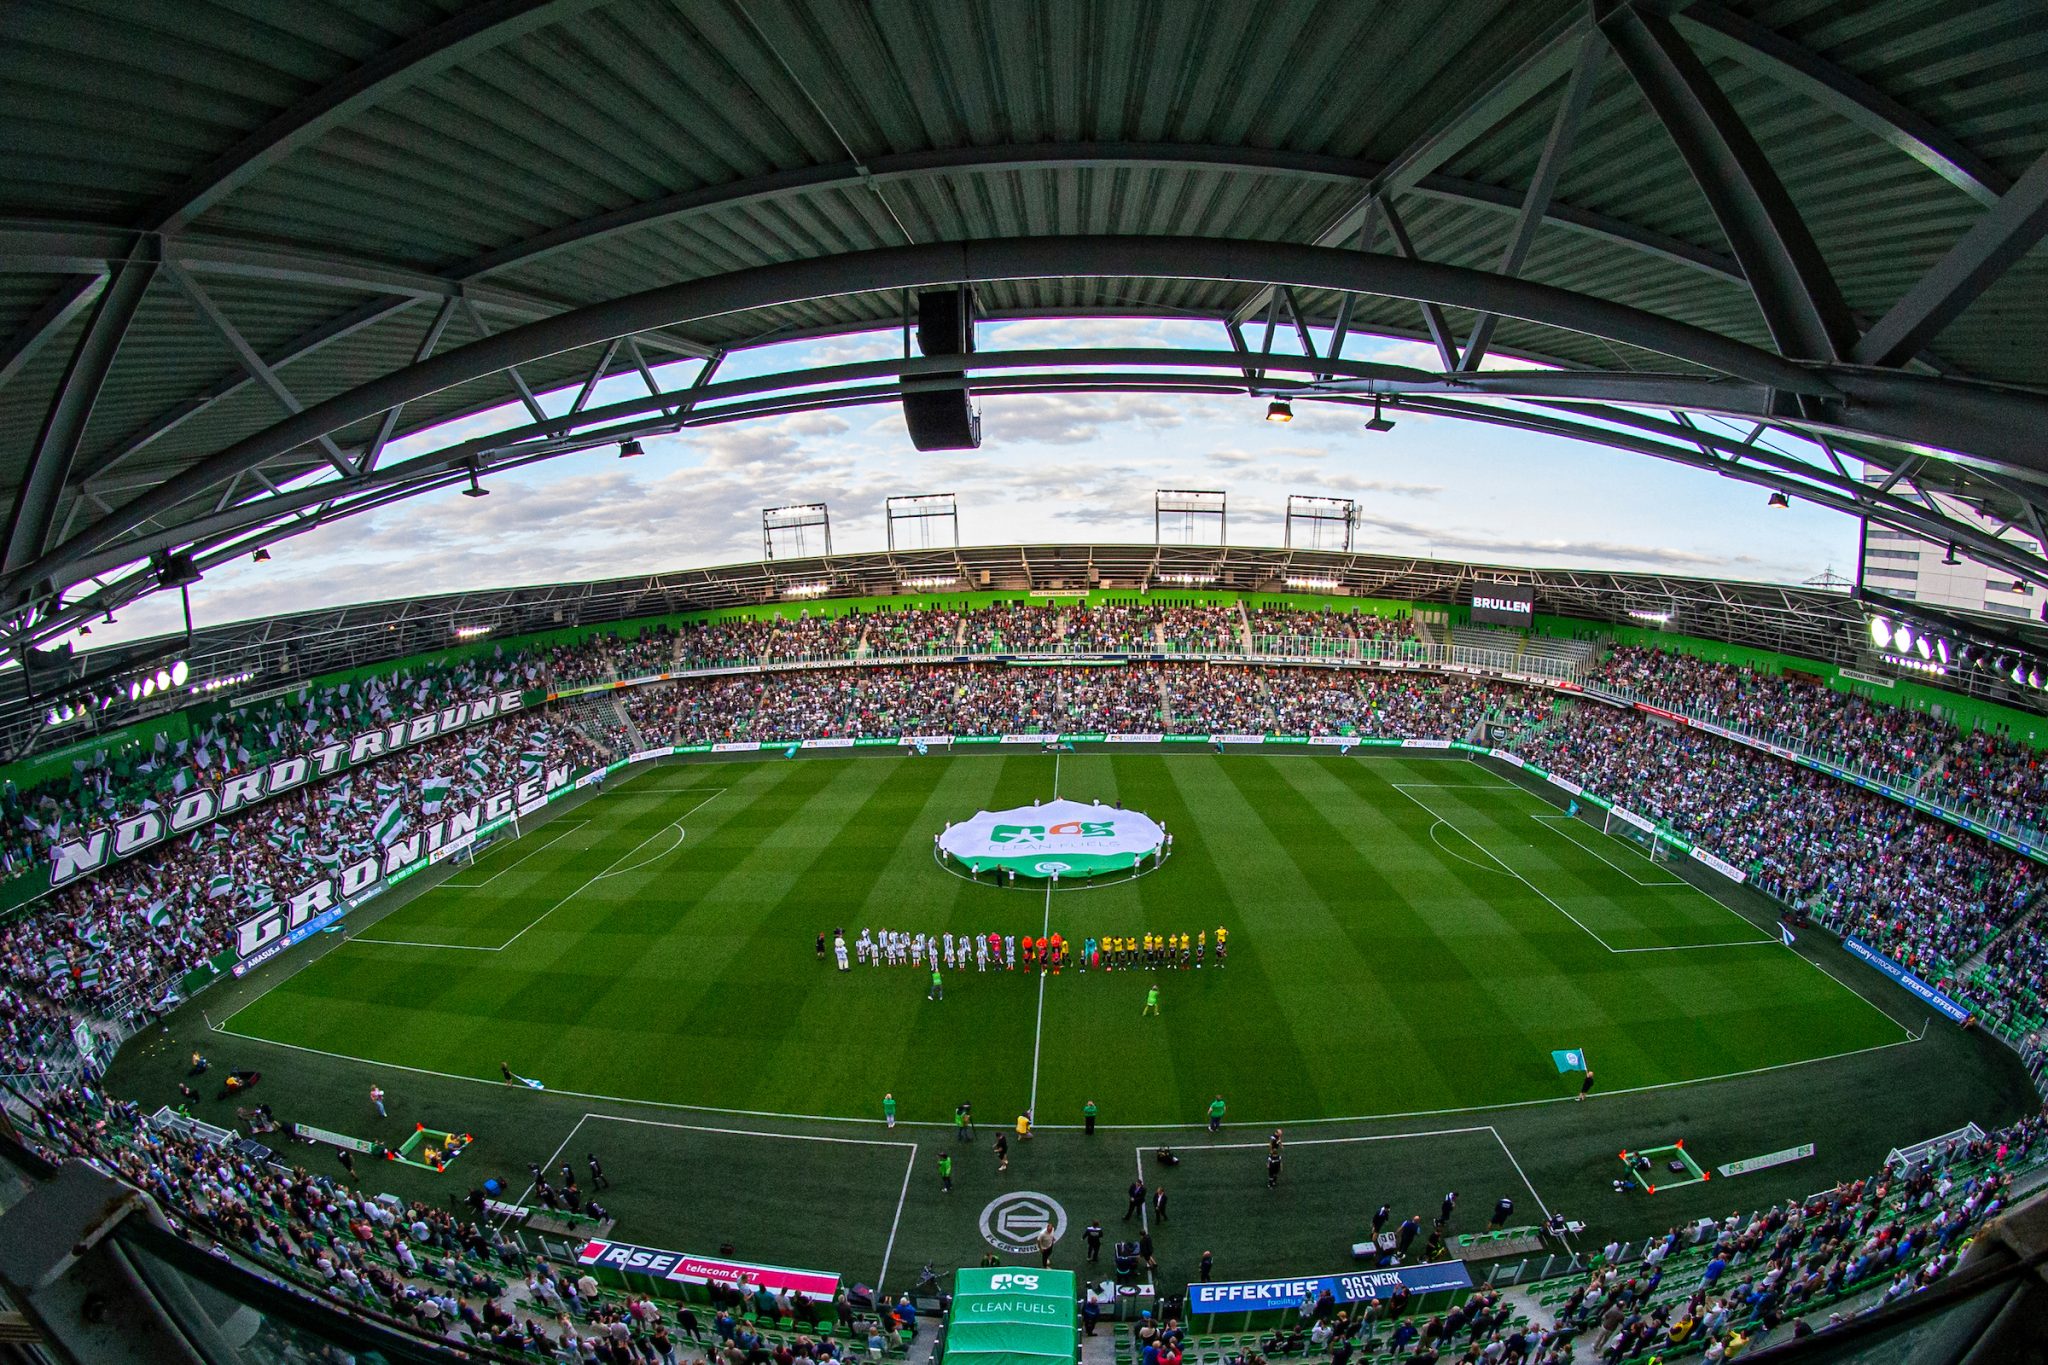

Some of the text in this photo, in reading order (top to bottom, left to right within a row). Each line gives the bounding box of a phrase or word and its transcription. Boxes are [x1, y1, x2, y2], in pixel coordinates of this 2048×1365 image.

[1473, 596, 1532, 614] BRULLEN
[1843, 671, 1889, 685] KOEMAN TRIBUNE
[51, 690, 524, 886] NOORDTRIBUNE
[444, 834, 474, 855] CLEAN FUELS
[988, 840, 1120, 852] CLEAN FUELS
[236, 764, 573, 958] GRONINGEN
[1708, 857, 1740, 879] CLEAN FUELS
[247, 945, 281, 969] AMASUS.nl
[1847, 939, 1873, 960] century
[1901, 975, 1967, 1020] EFFEKTIEF EFFEKTIEF
[986, 1234, 1038, 1253] FC GRONIN
[604, 1247, 675, 1271] RSE
[685, 1262, 730, 1278] telecom
[730, 1268, 739, 1278] &
[1200, 1280, 1319, 1302] EFFEKTIEF
[1341, 1271, 1403, 1300] 365 WERK
[971, 1302, 1056, 1314] CLEAN FUELS
[1267, 1297, 1296, 1307] facility
